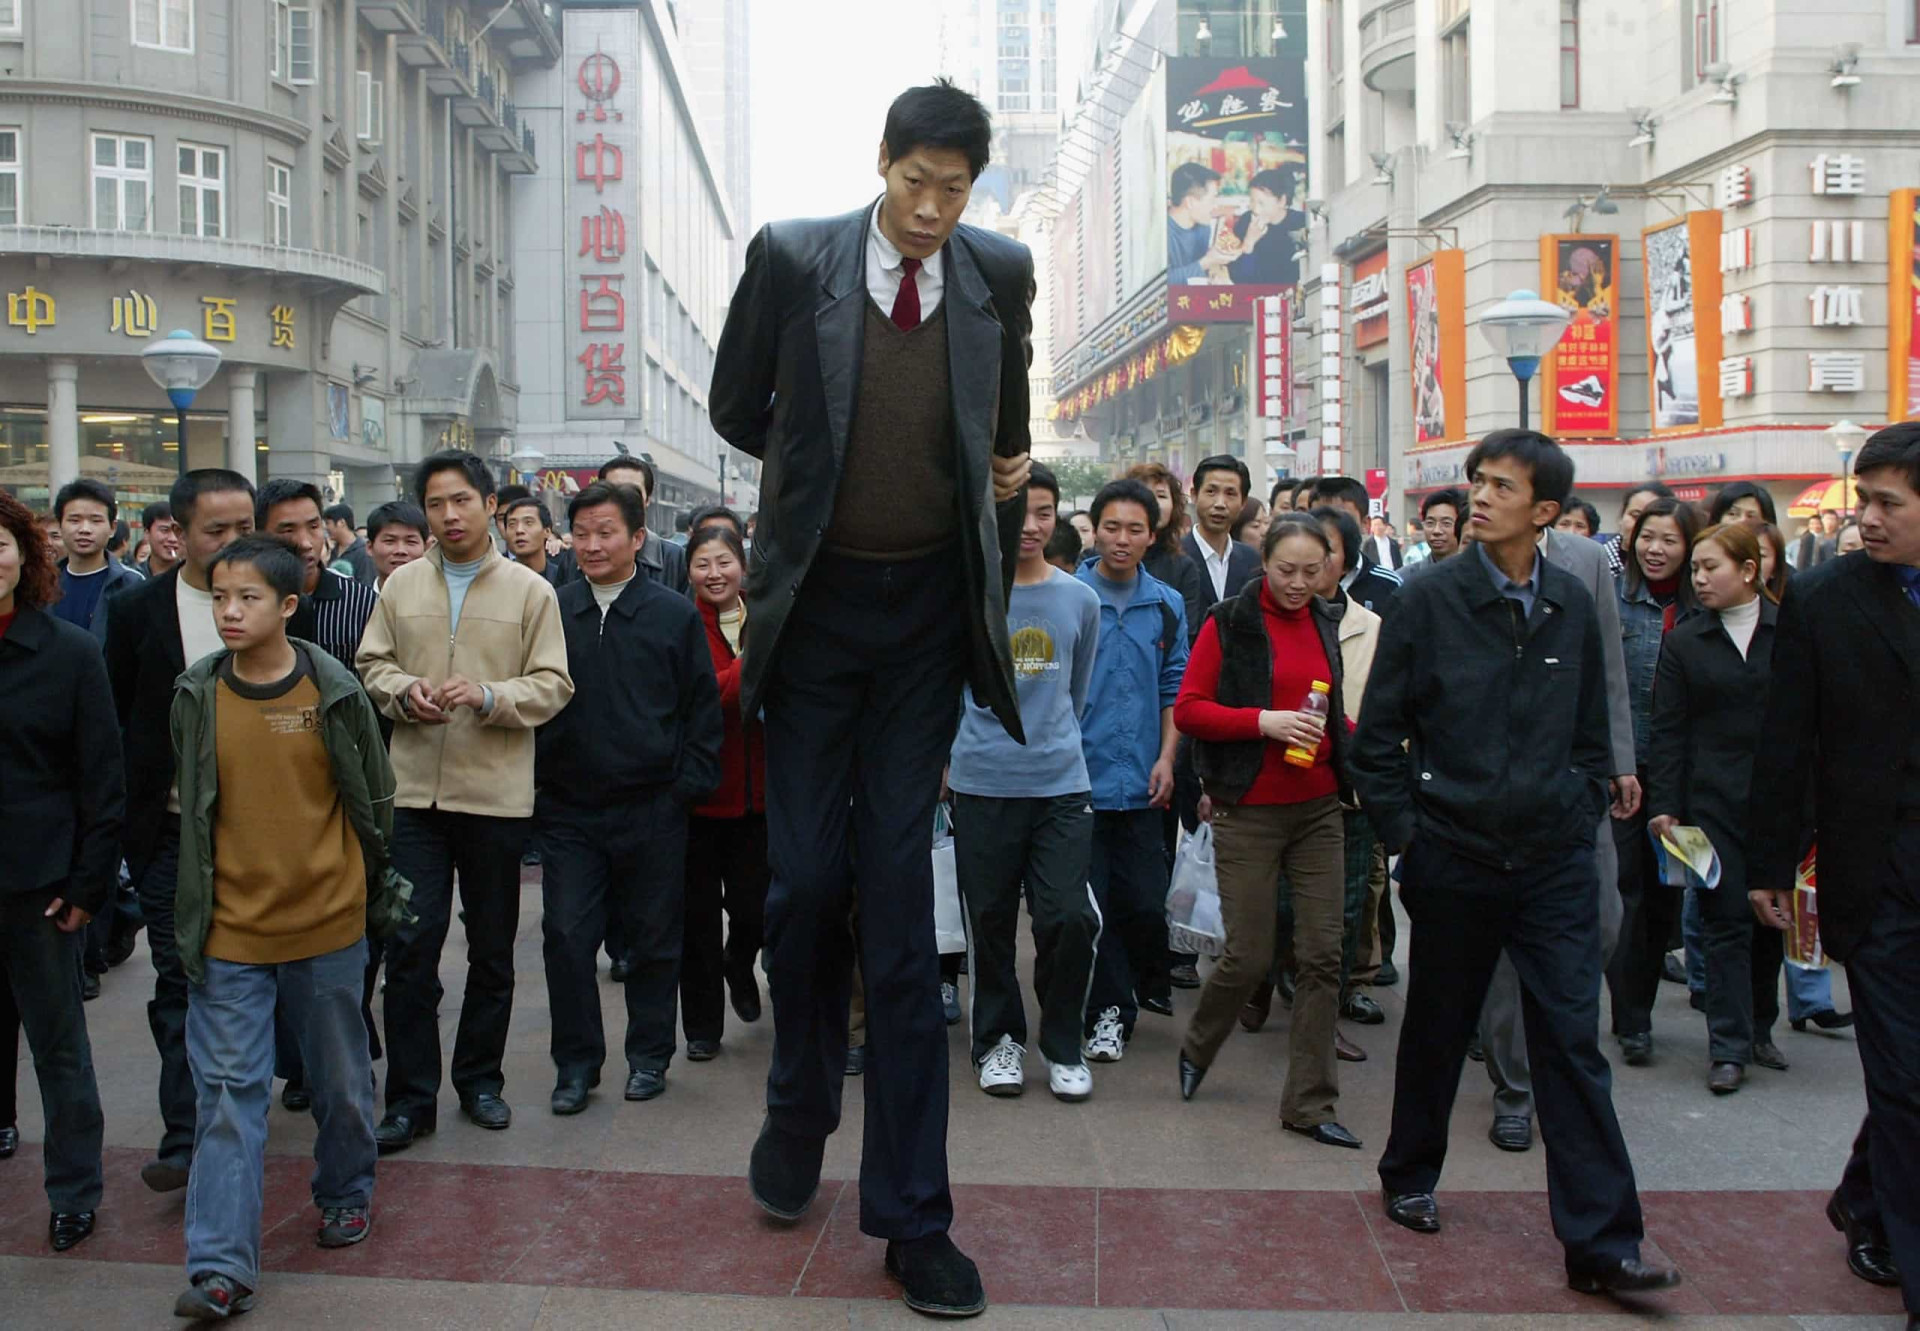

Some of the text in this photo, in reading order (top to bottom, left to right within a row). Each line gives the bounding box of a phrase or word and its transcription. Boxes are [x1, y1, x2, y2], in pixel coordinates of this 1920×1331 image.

[1177, 86, 1293, 123] 必胜客
[7, 285, 296, 348] 中心百货
[576, 132, 626, 406] 中心百货
[1808, 153, 1866, 393] 佳川体育
